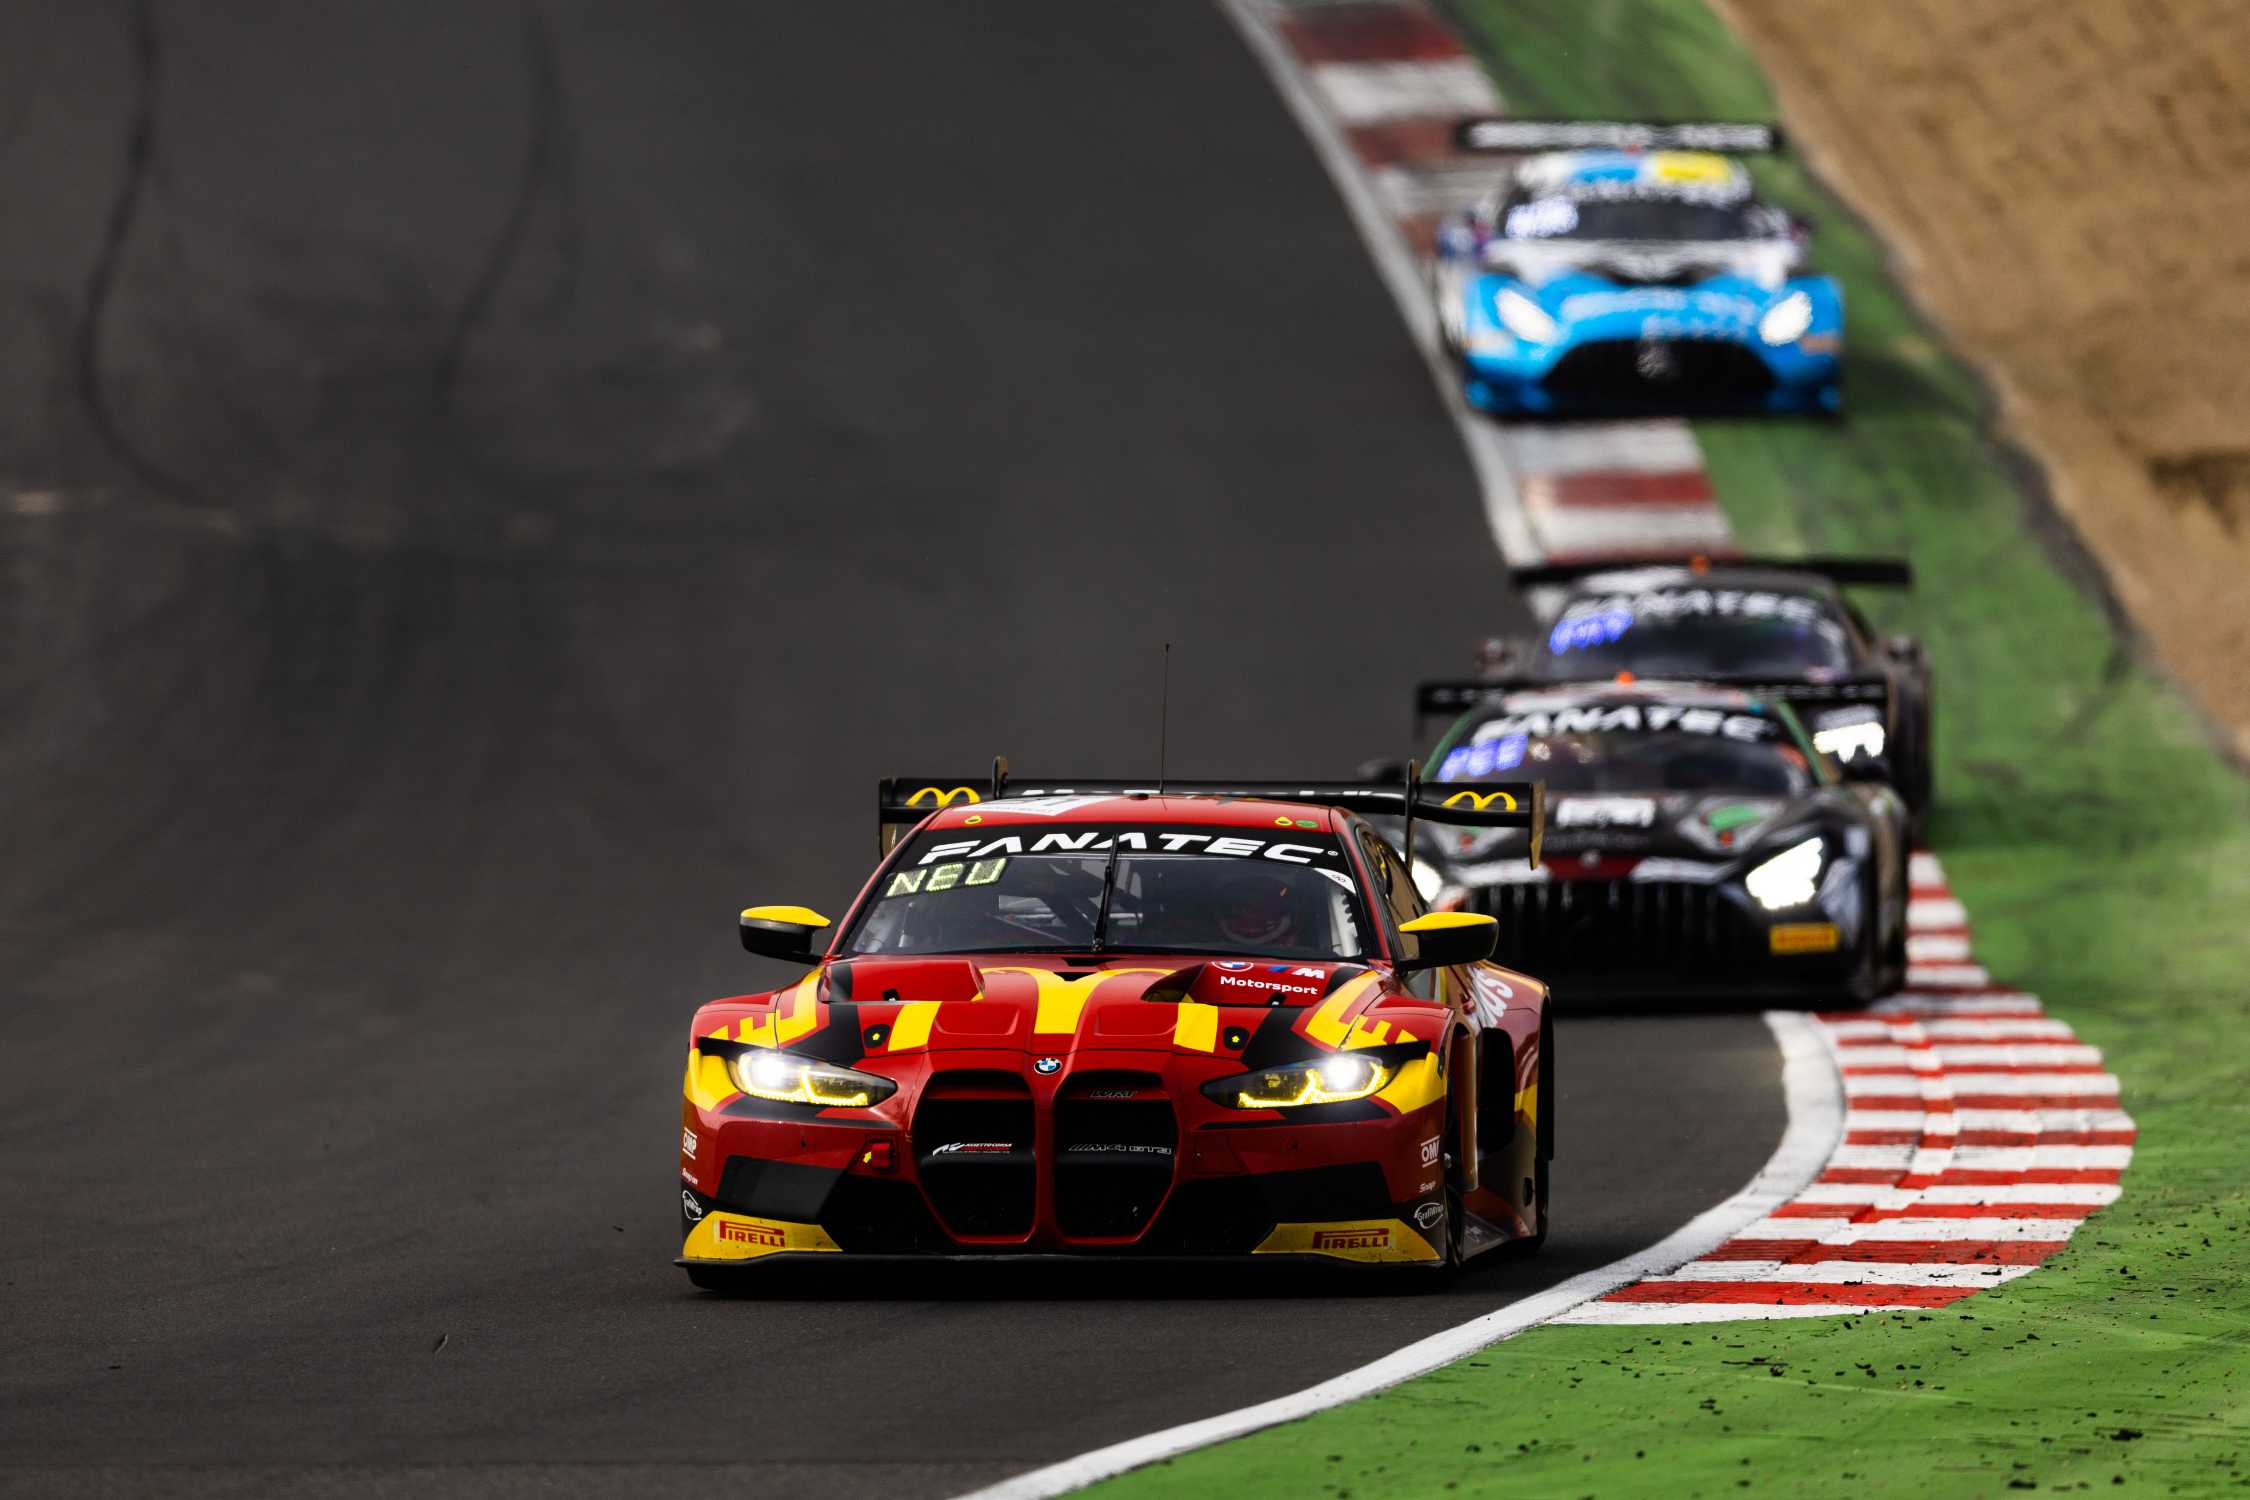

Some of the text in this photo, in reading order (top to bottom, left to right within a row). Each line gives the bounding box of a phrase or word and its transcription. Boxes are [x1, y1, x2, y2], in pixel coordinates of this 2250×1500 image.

[917, 831, 1325, 865] FANATEC
[886, 857, 1007, 896] NEU
[1220, 975, 1319, 995] Motorsport
[1421, 1139, 1441, 1162] OM
[719, 1220, 785, 1248] PIRELLI
[1312, 1227, 1389, 1250] PIRELLI
